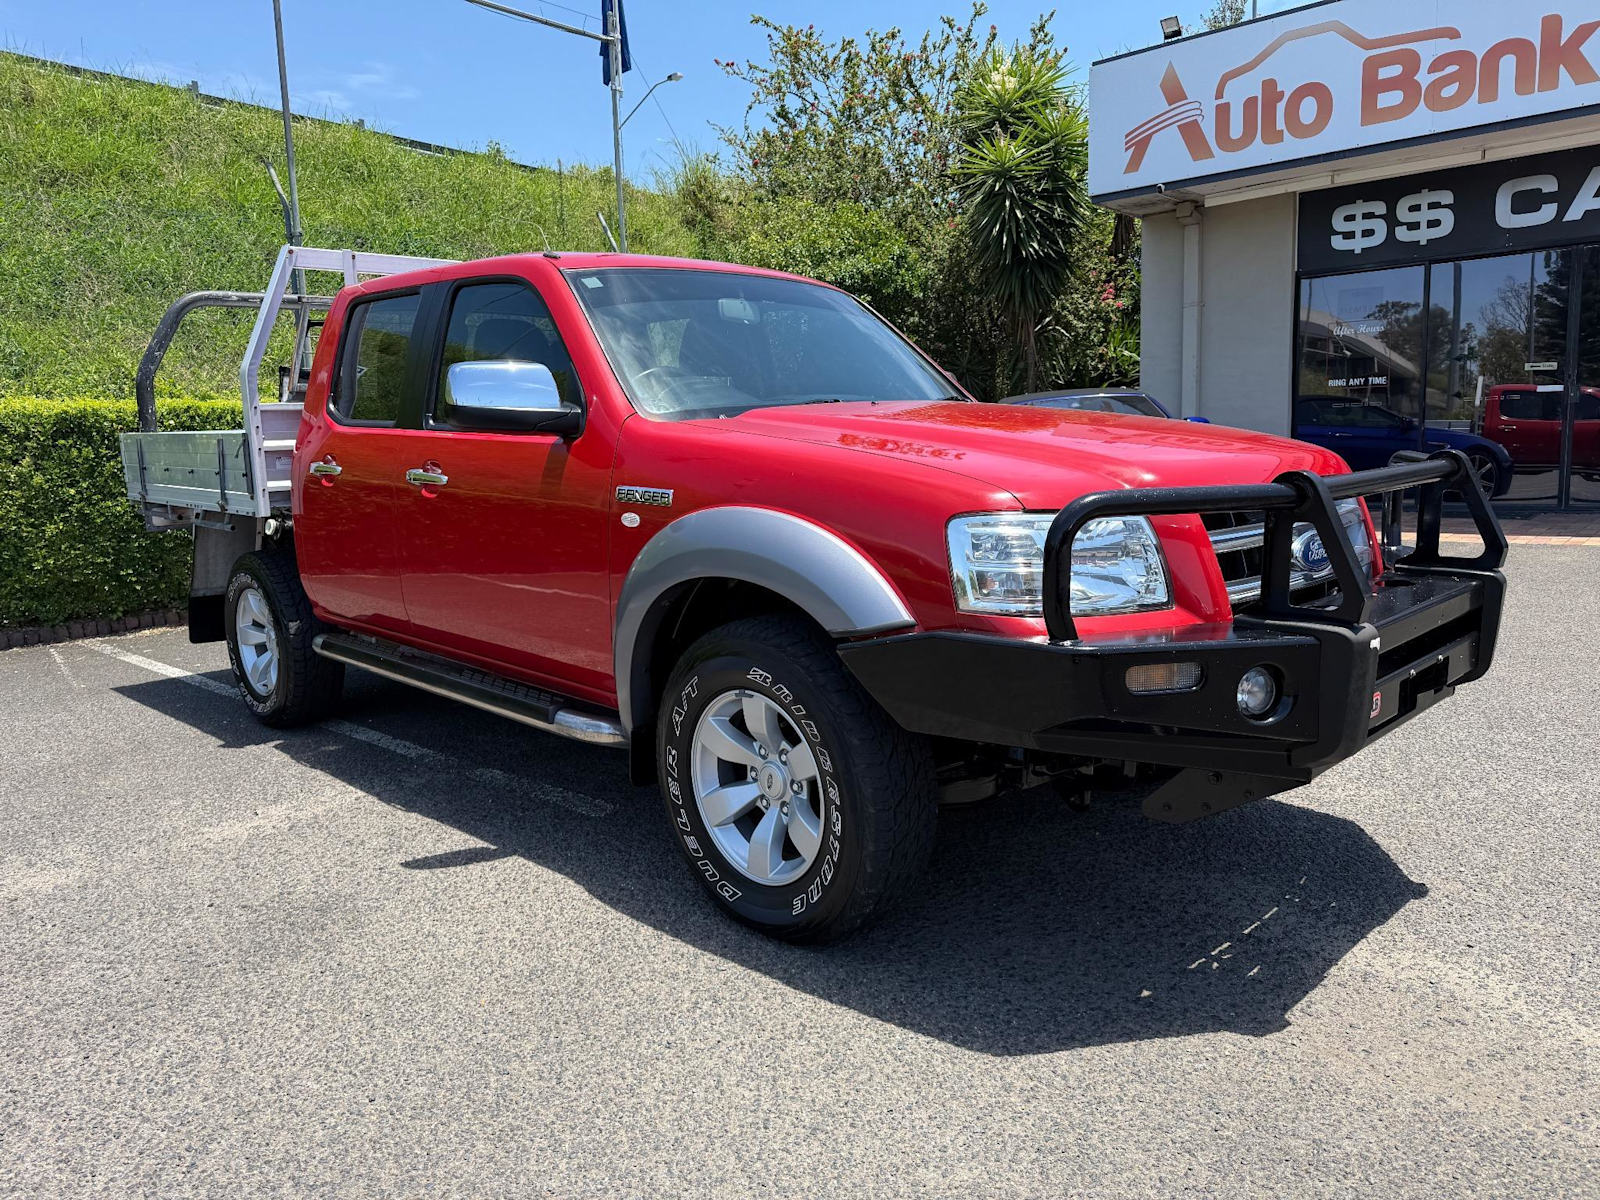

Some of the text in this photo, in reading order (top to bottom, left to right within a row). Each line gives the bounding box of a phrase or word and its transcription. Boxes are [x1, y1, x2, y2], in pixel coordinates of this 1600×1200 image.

[1123, 13, 1600, 175] Auto Bank
[1330, 188, 1455, 254] $$
[1333, 324, 1385, 338] After Hours
[1328, 376, 1387, 387] RING ANY TIME
[615, 486, 673, 506] RANGER
[666, 746, 742, 901] DUELER
